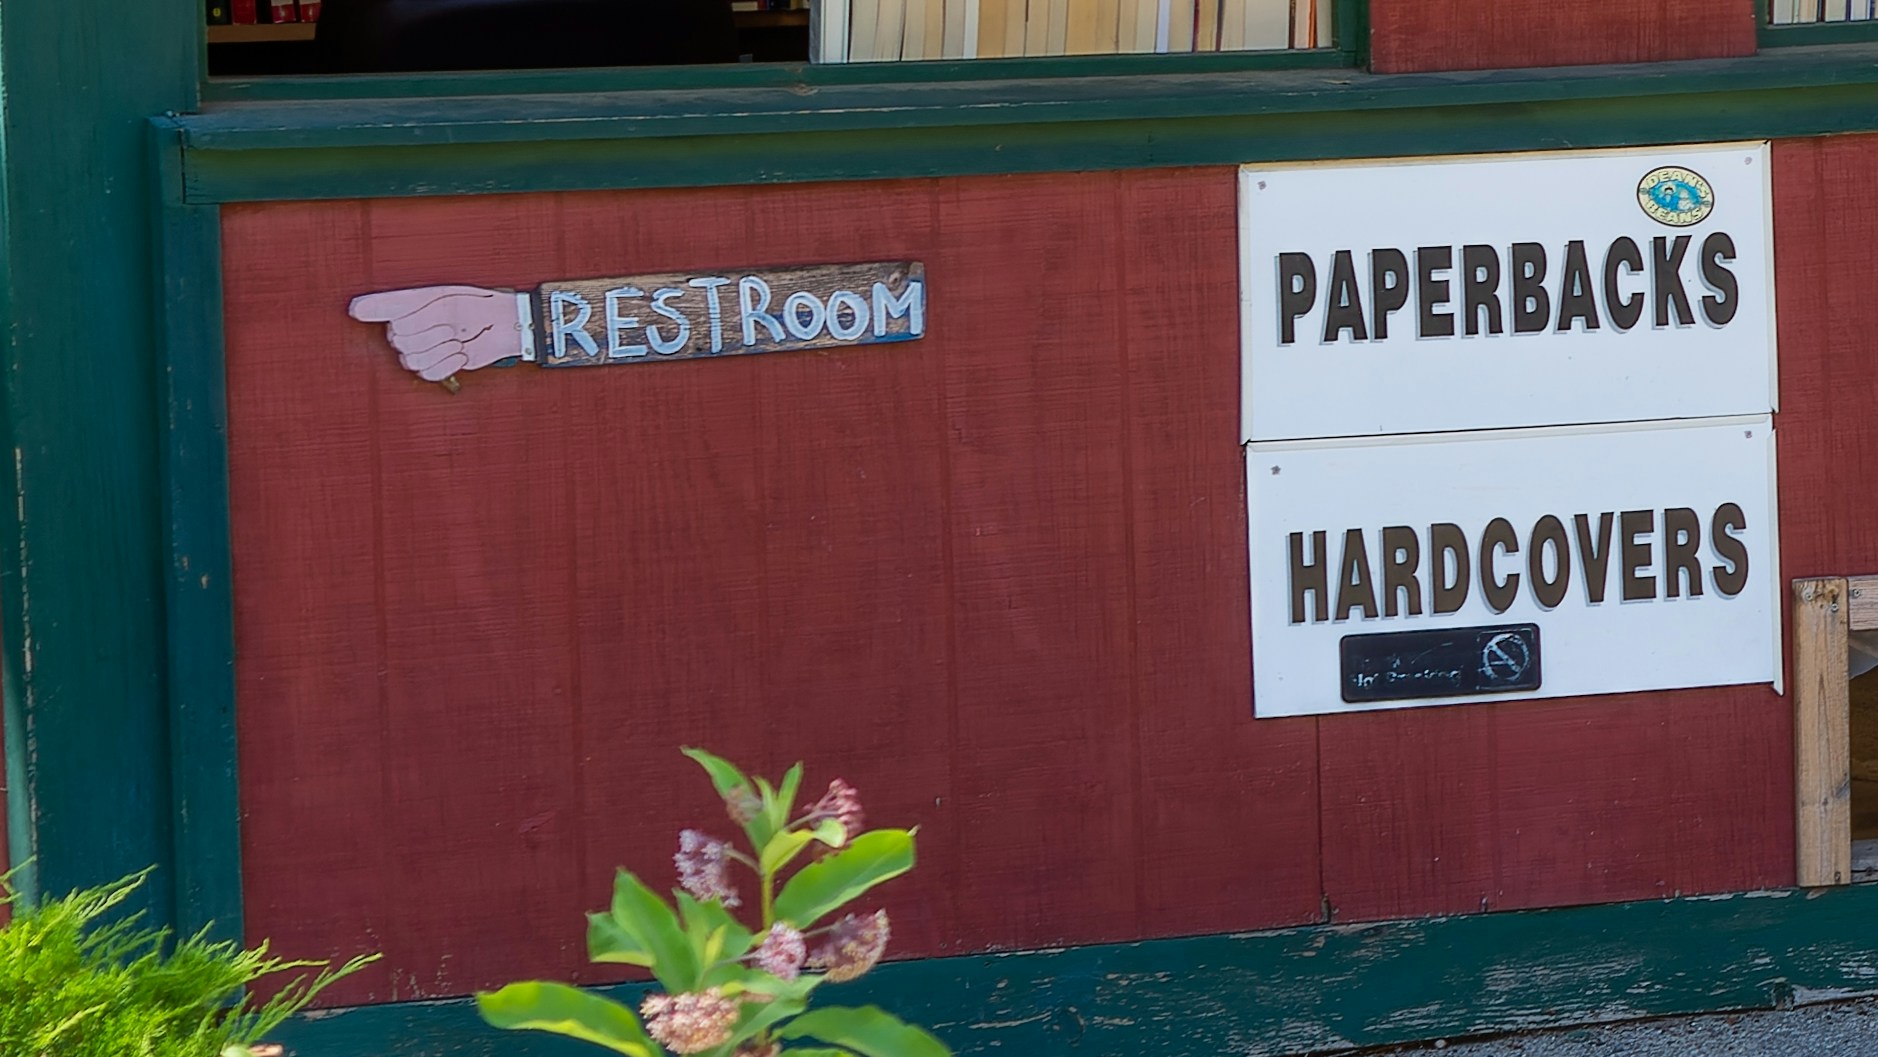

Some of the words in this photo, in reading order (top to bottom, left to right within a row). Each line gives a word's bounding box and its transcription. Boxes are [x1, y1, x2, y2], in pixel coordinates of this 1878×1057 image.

[1645, 199, 1702, 224] BEANS
[1646, 171, 1709, 198] DEAN'S
[551, 274, 924, 358] RESTROOM
[1275, 232, 1738, 346] PAPERBACKS
[1288, 502, 1749, 625] HARDCOVERS
